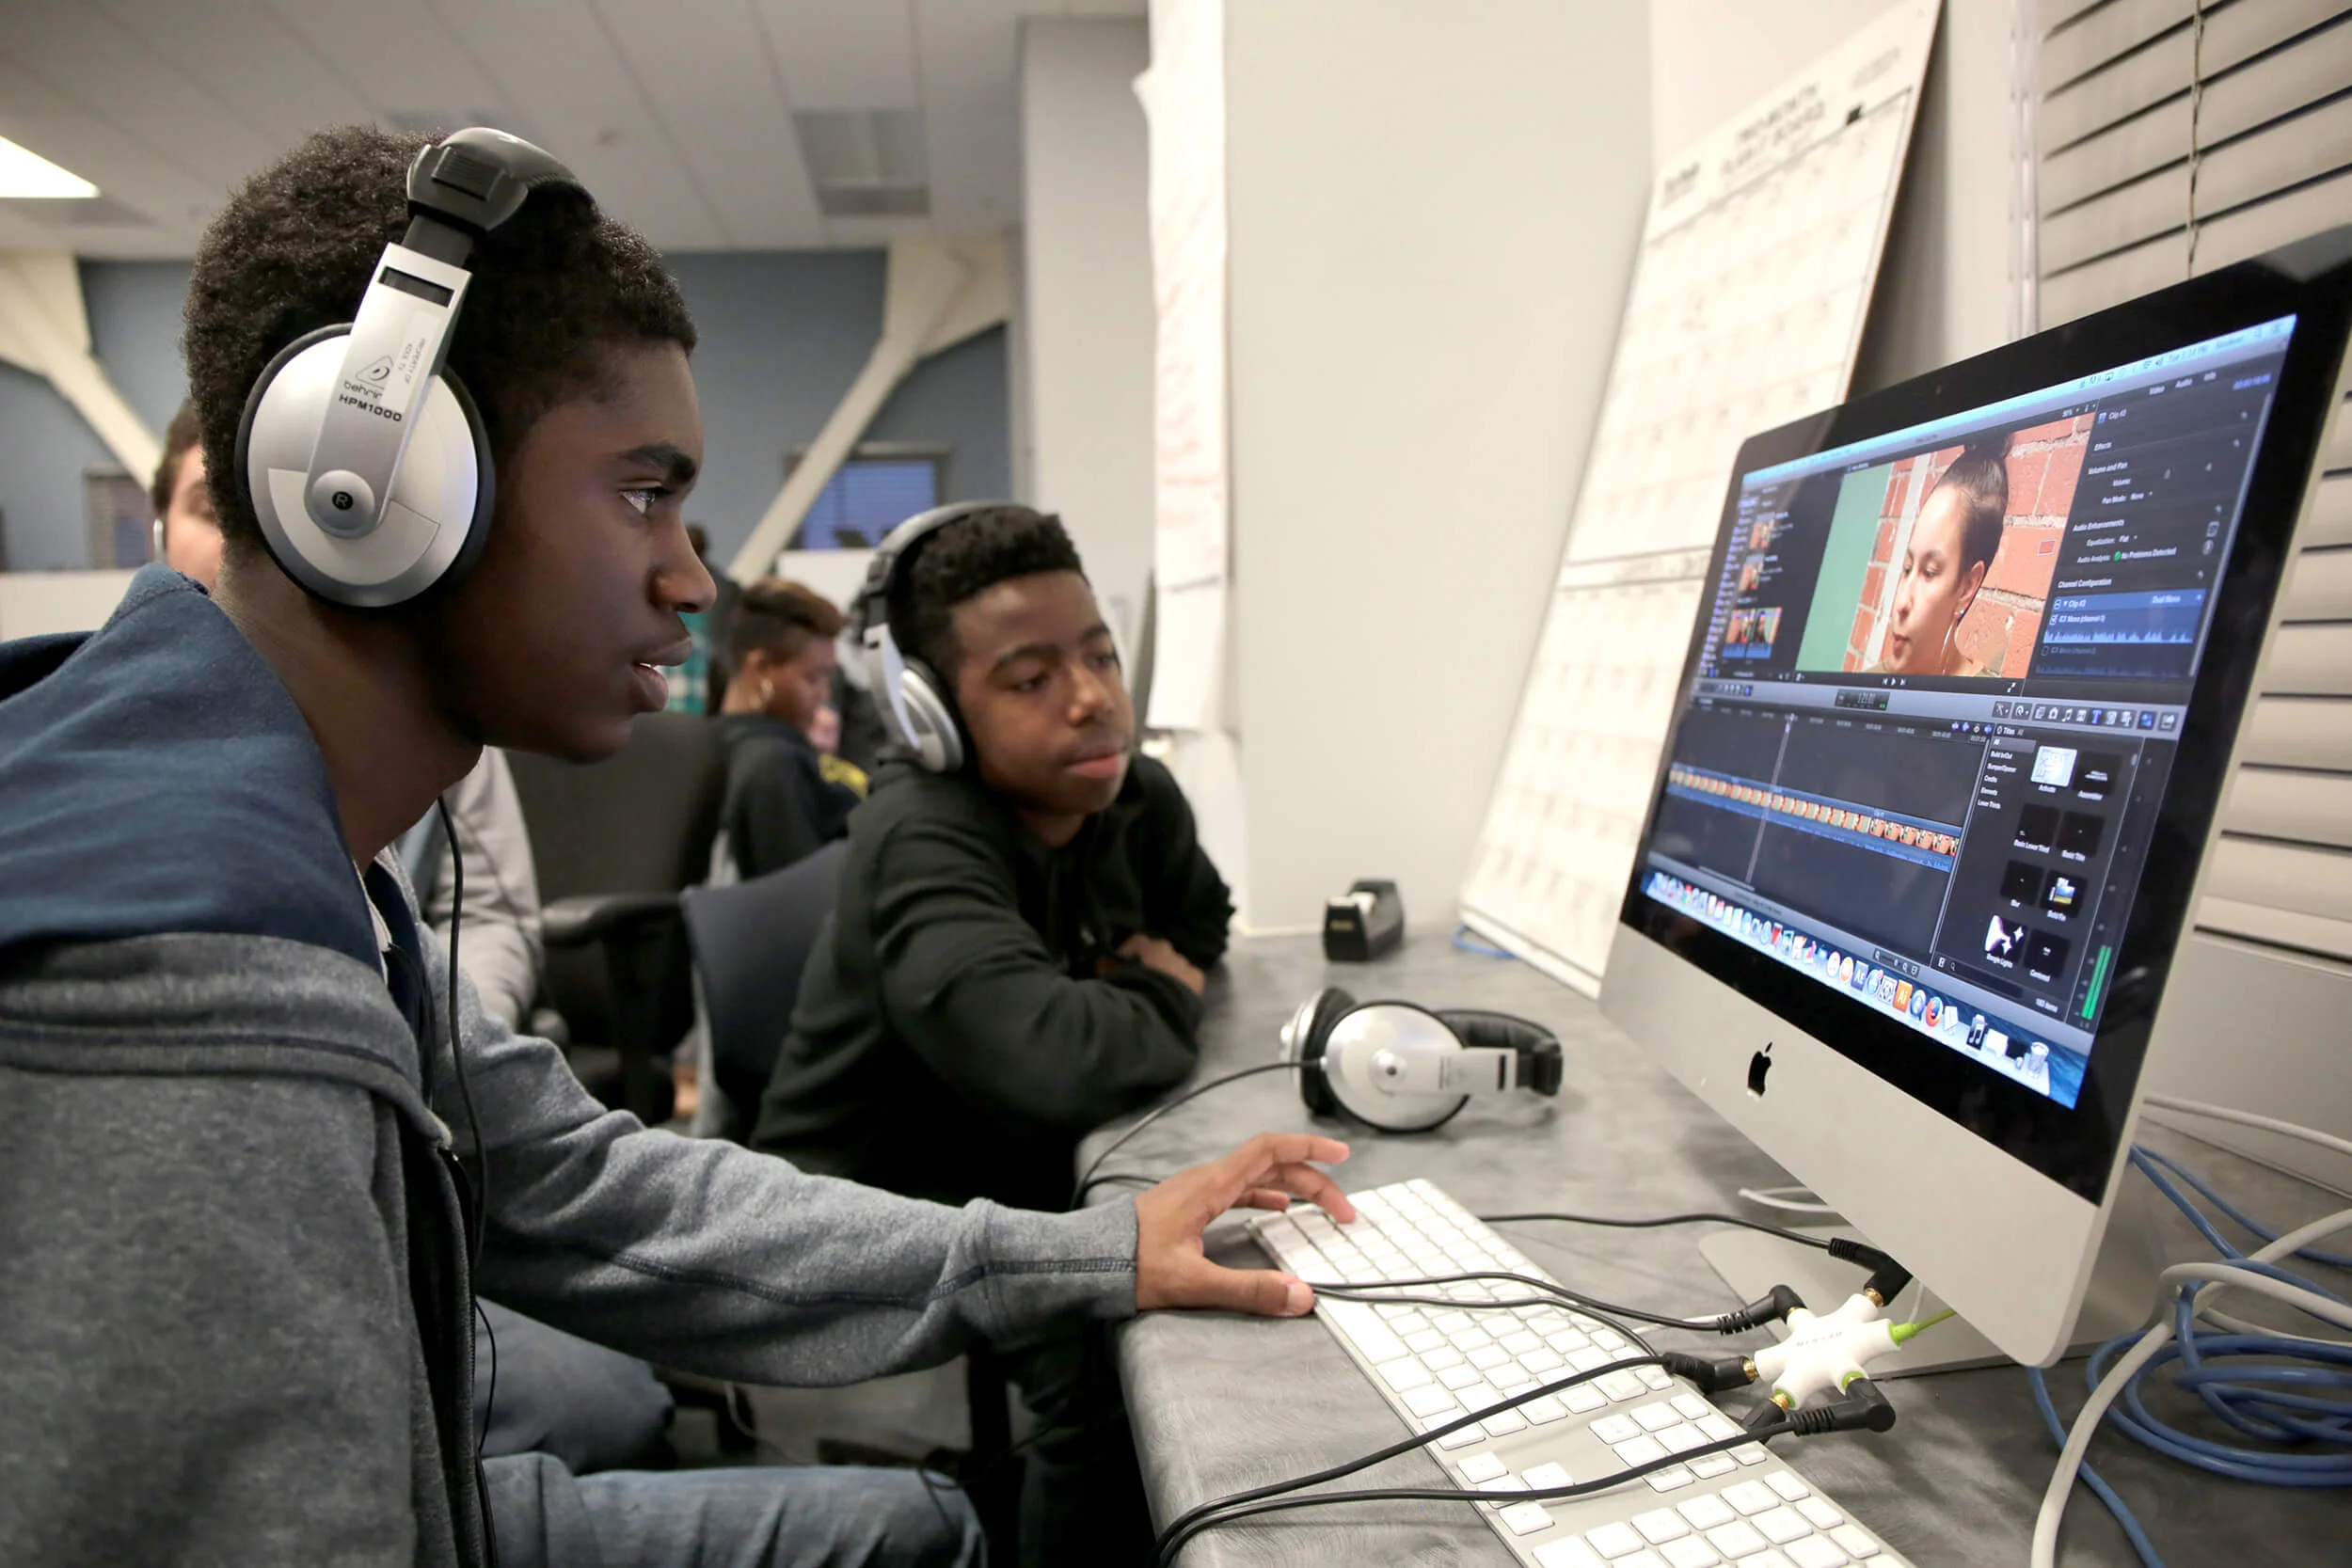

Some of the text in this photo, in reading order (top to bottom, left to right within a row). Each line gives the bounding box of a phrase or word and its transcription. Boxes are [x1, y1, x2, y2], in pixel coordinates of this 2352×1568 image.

[339, 393, 403, 422] HPM1000
[335, 493, 348, 509] R
[1897, 989, 1908, 1006] Ai
